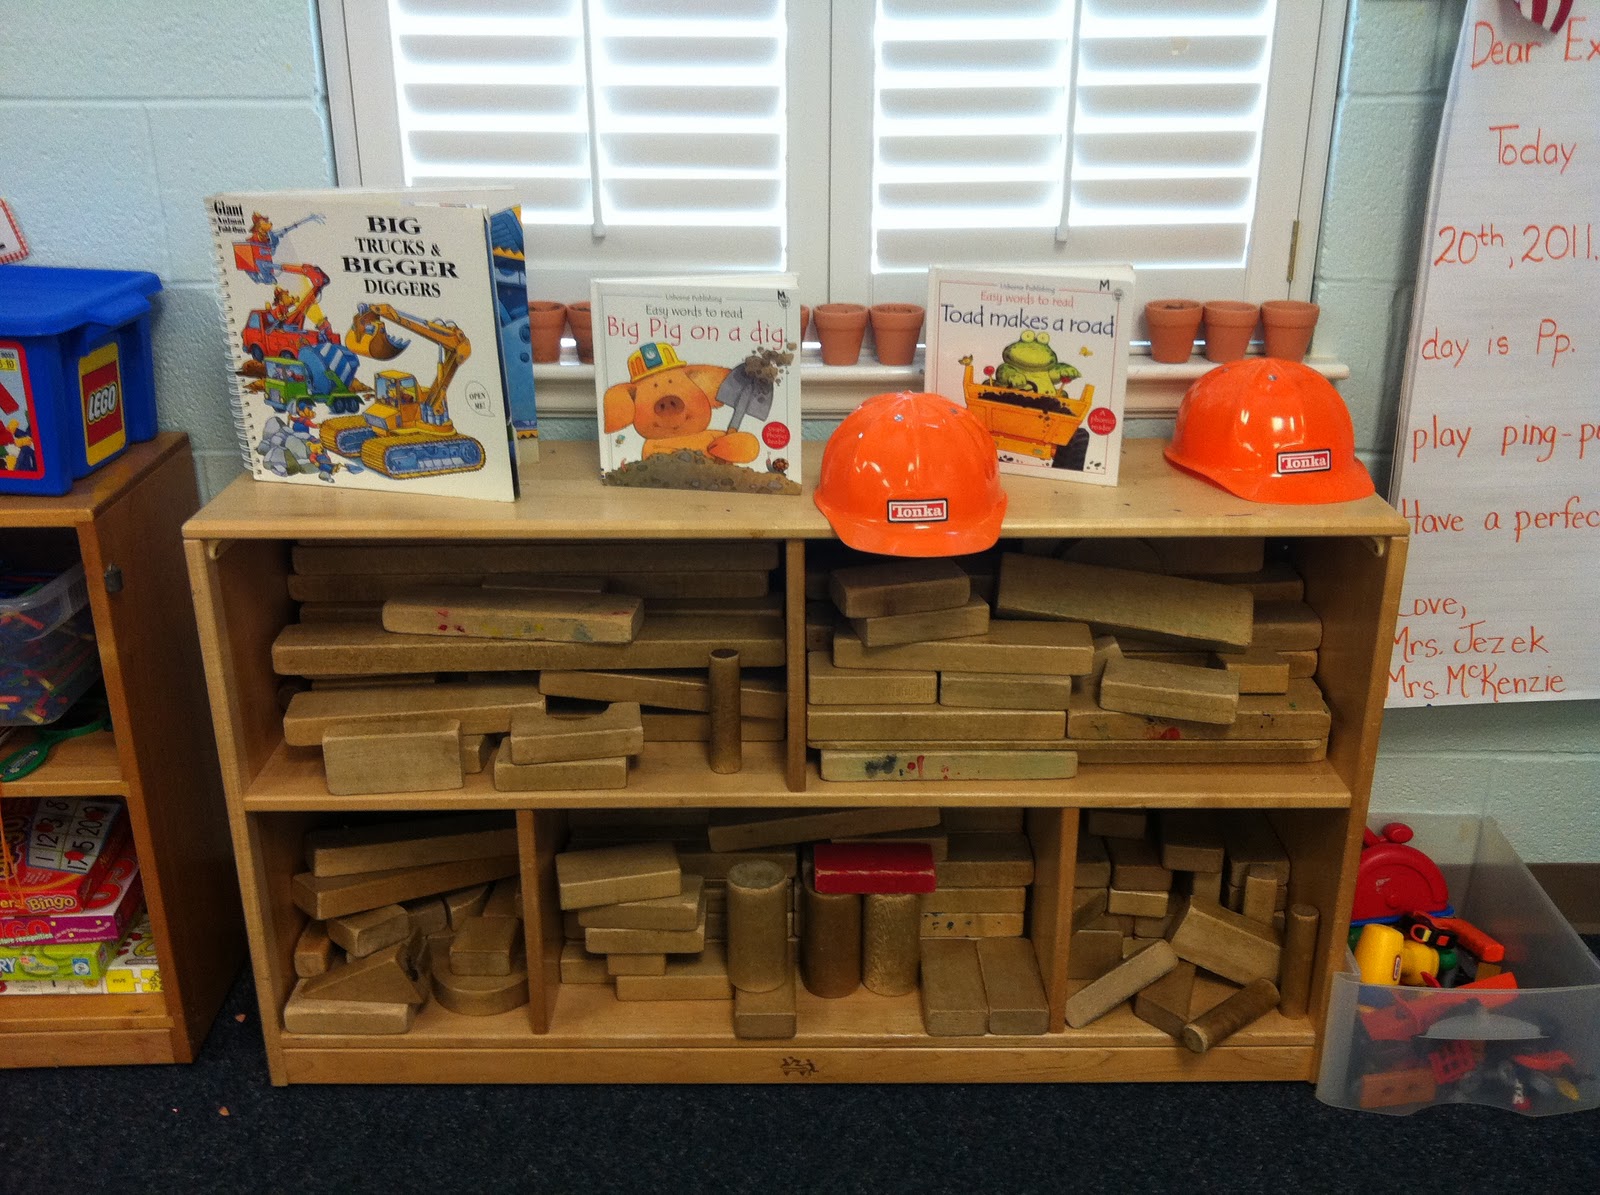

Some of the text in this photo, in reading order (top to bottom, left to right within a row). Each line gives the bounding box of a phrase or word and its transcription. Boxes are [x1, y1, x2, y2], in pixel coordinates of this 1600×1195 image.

[1471, 20, 1543, 70] Dear
[1489, 124, 1577, 174] Today
[214, 199, 243, 217] Giant
[366, 215, 422, 235] BIG
[355, 237, 442, 257] TRUCKS &
[341, 255, 459, 279] BIGGER
[363, 278, 442, 298] DIGGERS
[980, 291, 1075, 309] Easy words to read
[645, 304, 744, 320] Easy words to read
[941, 303, 1115, 339] Toad makes a road
[607, 314, 784, 351] Big Pig on a dig
[1421, 318, 1576, 368] day is Pp.
[88, 382, 117, 424] LEGO
[469, 392, 486, 400] OPEN
[1412, 415, 1600, 463] play ping-p
[1282, 456, 1326, 469] Tonka
[892, 505, 942, 518] Tonka
[1402, 499, 1464, 535] Have
[1484, 511, 1500, 530] a
[1394, 620, 1550, 664] Mrs. Jezek
[1388, 662, 1567, 703] Mrs. McKenzie
[27, 896, 75, 911] Bingo
